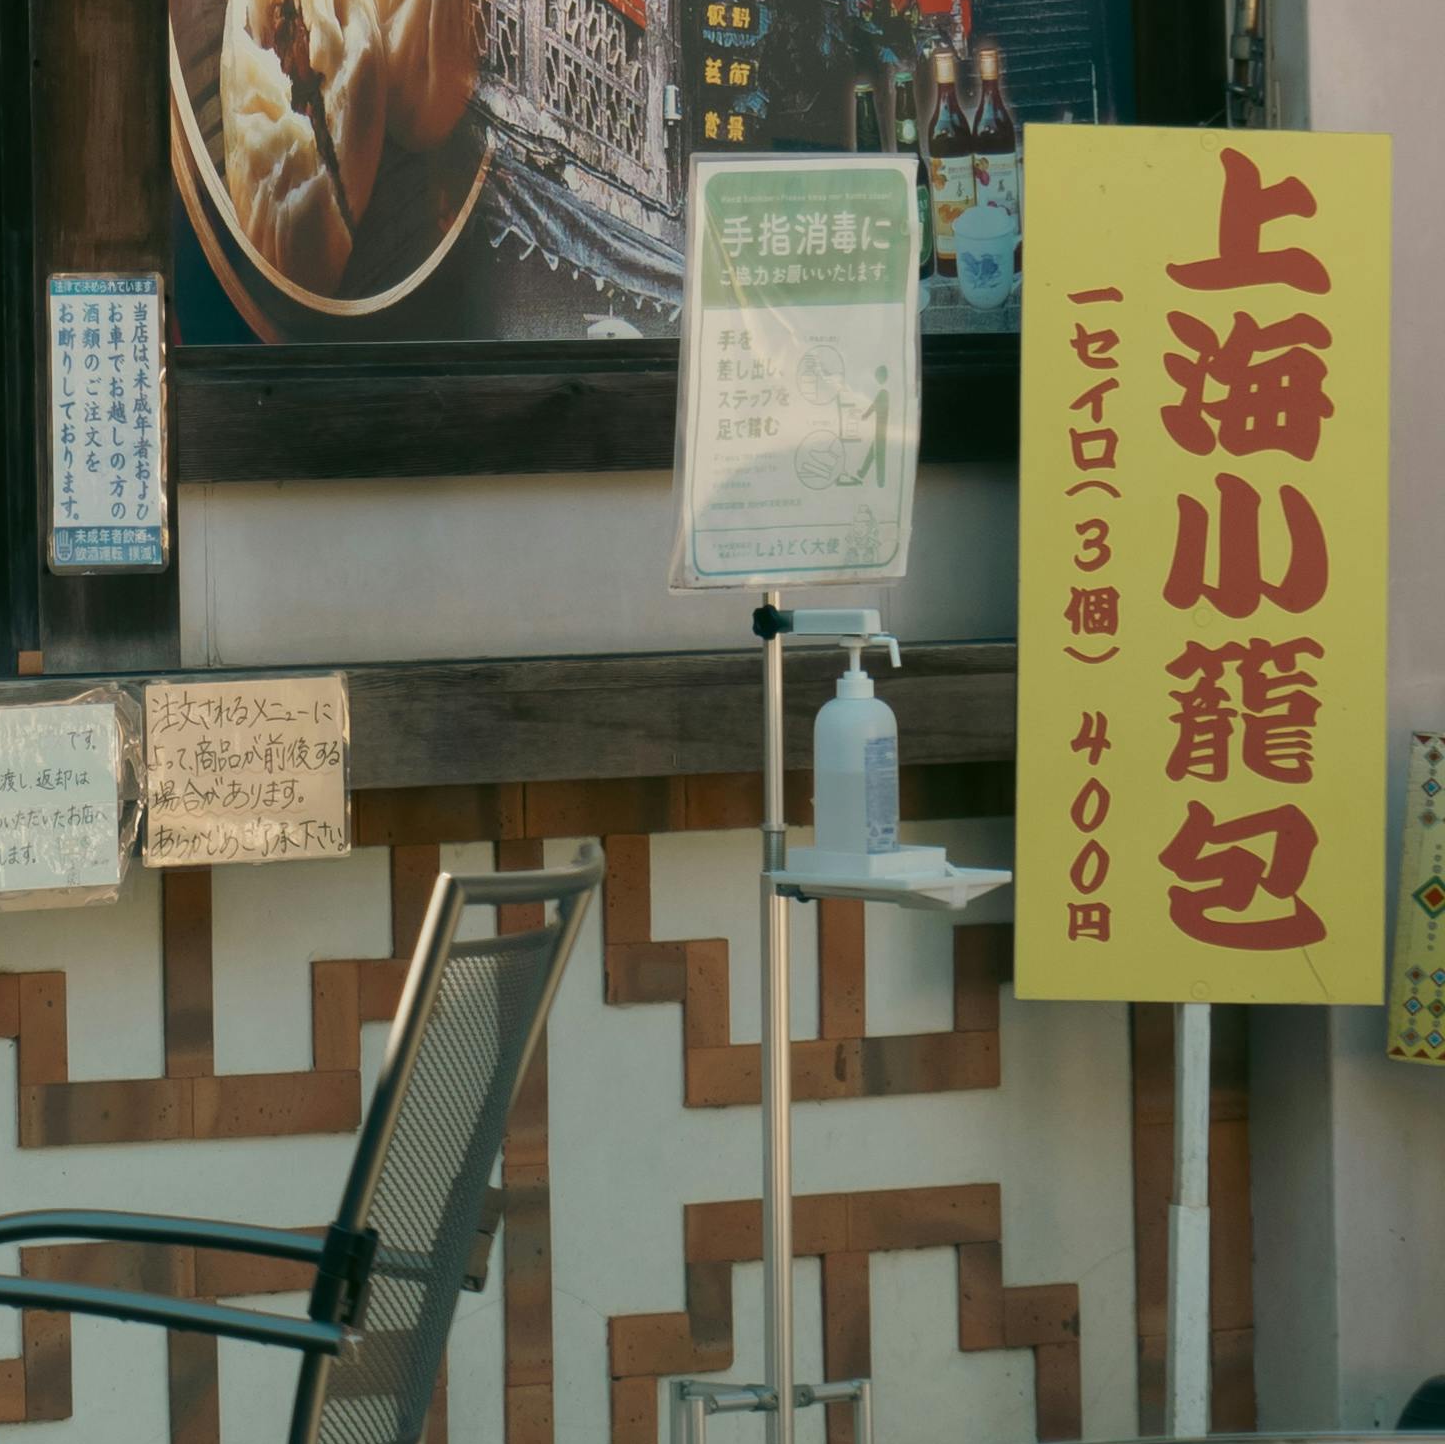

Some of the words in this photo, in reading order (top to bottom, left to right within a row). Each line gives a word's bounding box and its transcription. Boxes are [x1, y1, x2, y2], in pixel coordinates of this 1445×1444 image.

[721, 210, 892, 258] 手指消毒に
[82, 303, 102, 473] 酒類のご注文を
[717, 330, 753, 351] 手を
[57, 303, 80, 522] お断りしております。
[107, 301, 127, 521] お車でお越しの方の
[131, 301, 155, 521] 当店は、未成年者および
[716, 415, 780, 441] 足で踏む
[1158, 147, 1335, 952] 上海小籠包
[150, 690, 334, 734] 注文されるメニューに
[150, 778, 305, 814] 場合があります。
